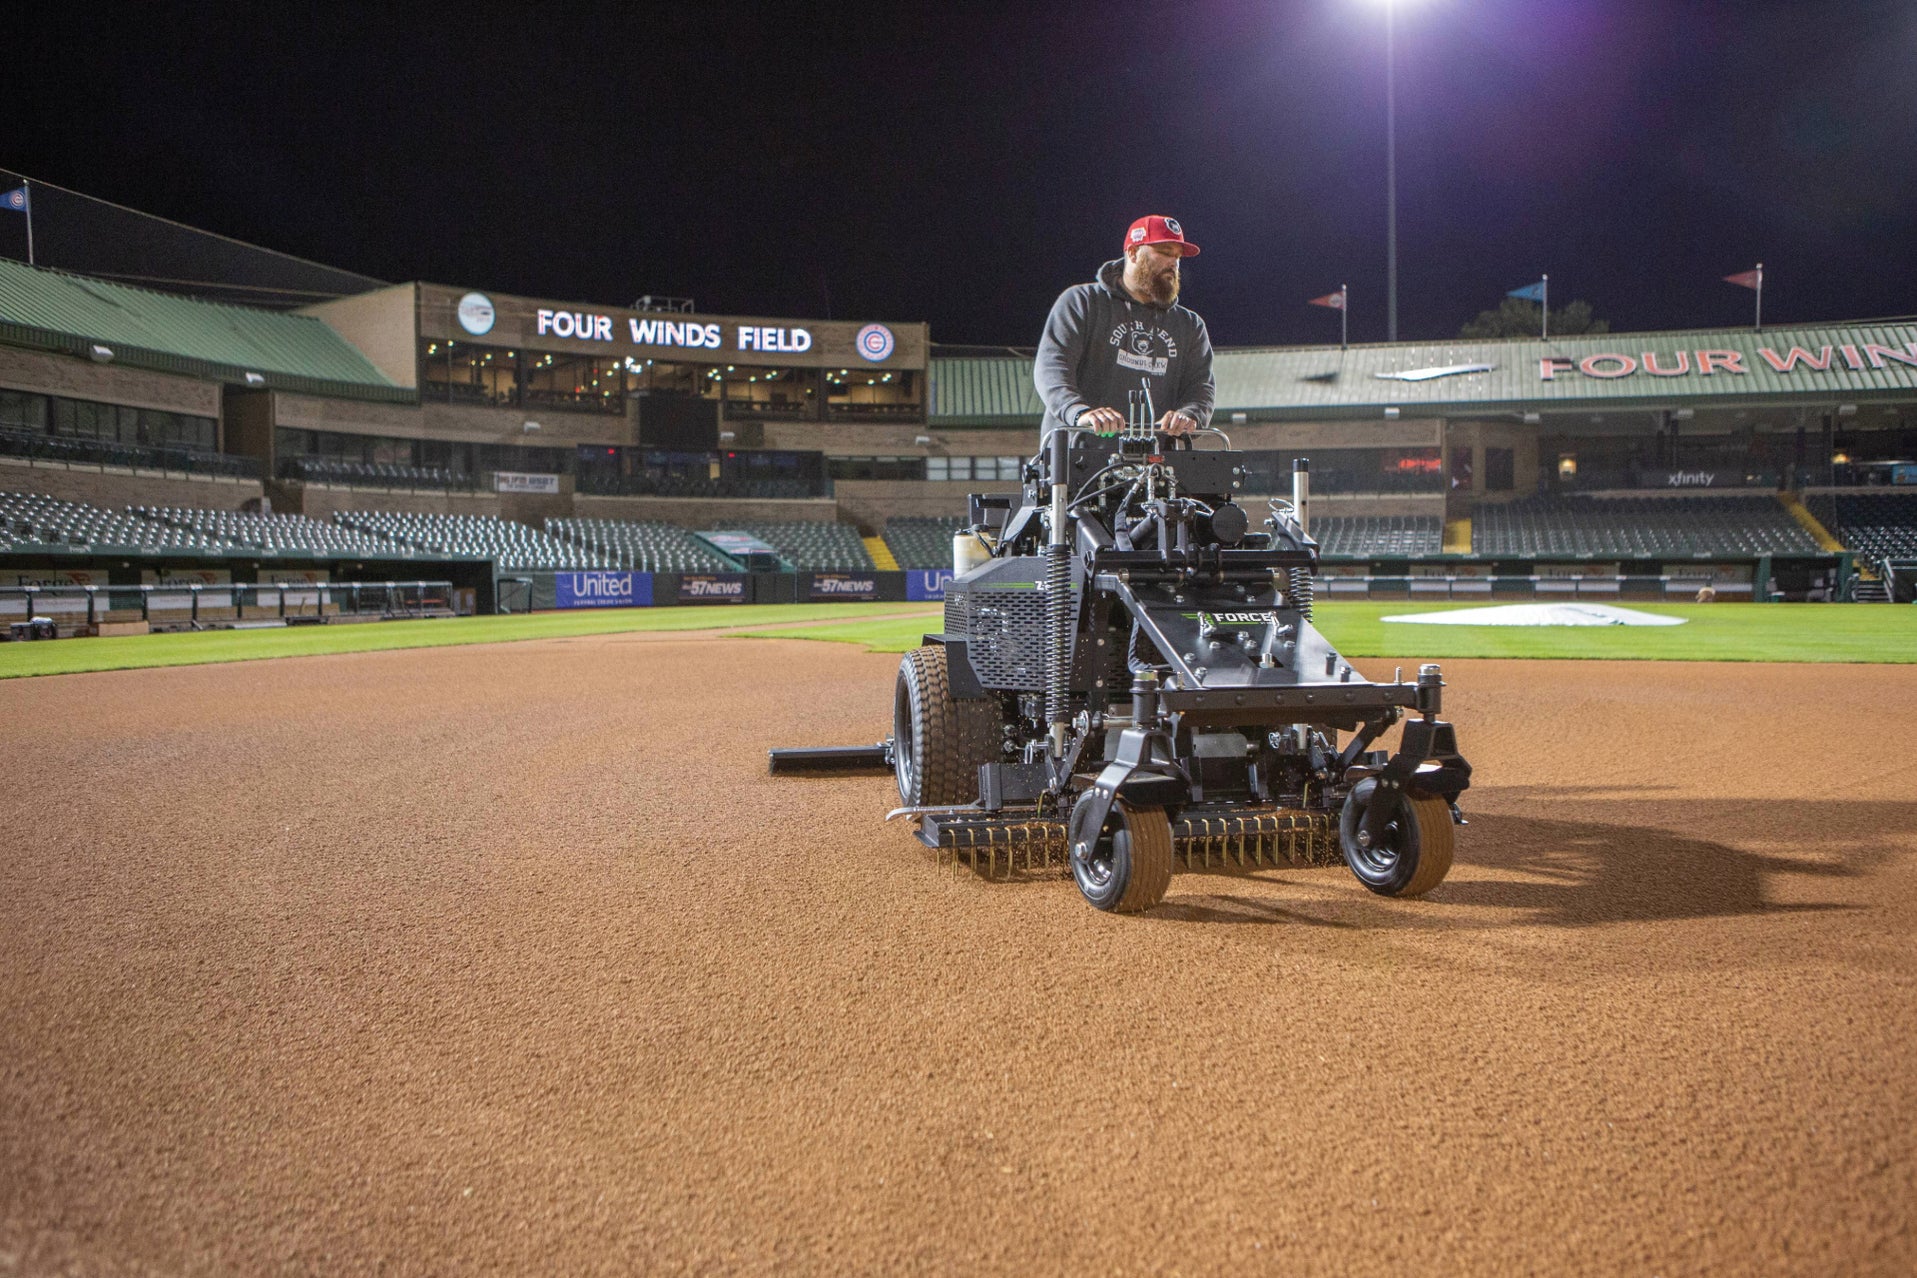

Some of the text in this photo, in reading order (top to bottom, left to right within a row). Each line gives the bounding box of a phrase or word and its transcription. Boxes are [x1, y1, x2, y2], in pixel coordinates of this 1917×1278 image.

[537, 309, 812, 352] FOUR WINDS FIELD
[1150, 326, 1177, 357] END
[1539, 349, 1750, 381] FOUR
[1668, 470, 1715, 487] xfinity
[573, 572, 632, 596] United
[1212, 612, 1272, 622] FORCE
